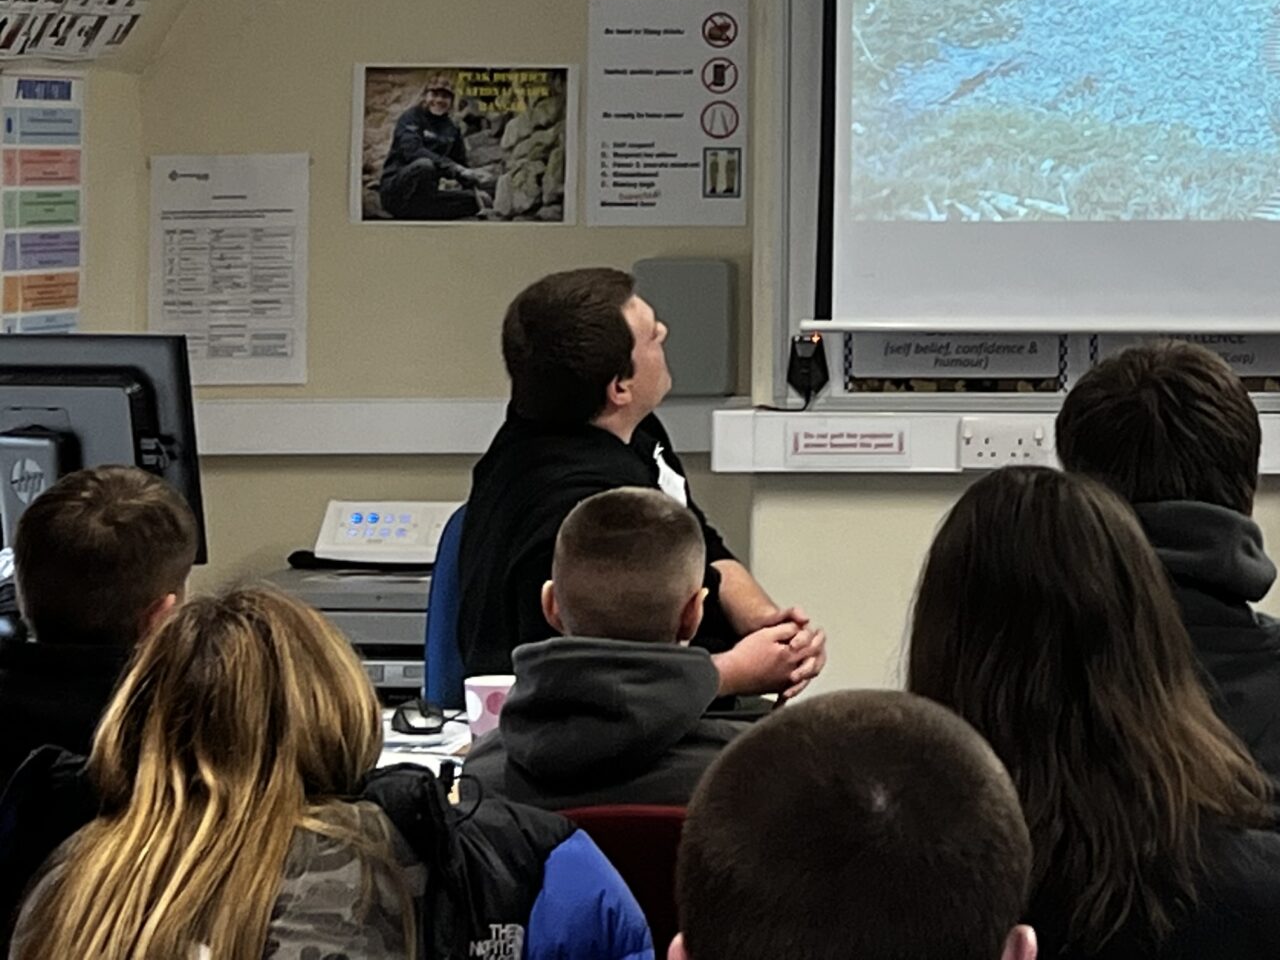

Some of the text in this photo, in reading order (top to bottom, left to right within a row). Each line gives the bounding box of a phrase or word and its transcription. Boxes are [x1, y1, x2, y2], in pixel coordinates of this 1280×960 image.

[884, 341, 912, 357] (self
[955, 341, 1025, 357] confidence
[1028, 342, 1038, 355] &
[933, 355, 990, 370] humour)
[488, 923, 519, 940] THE
[469, 940, 516, 957] NORTH
